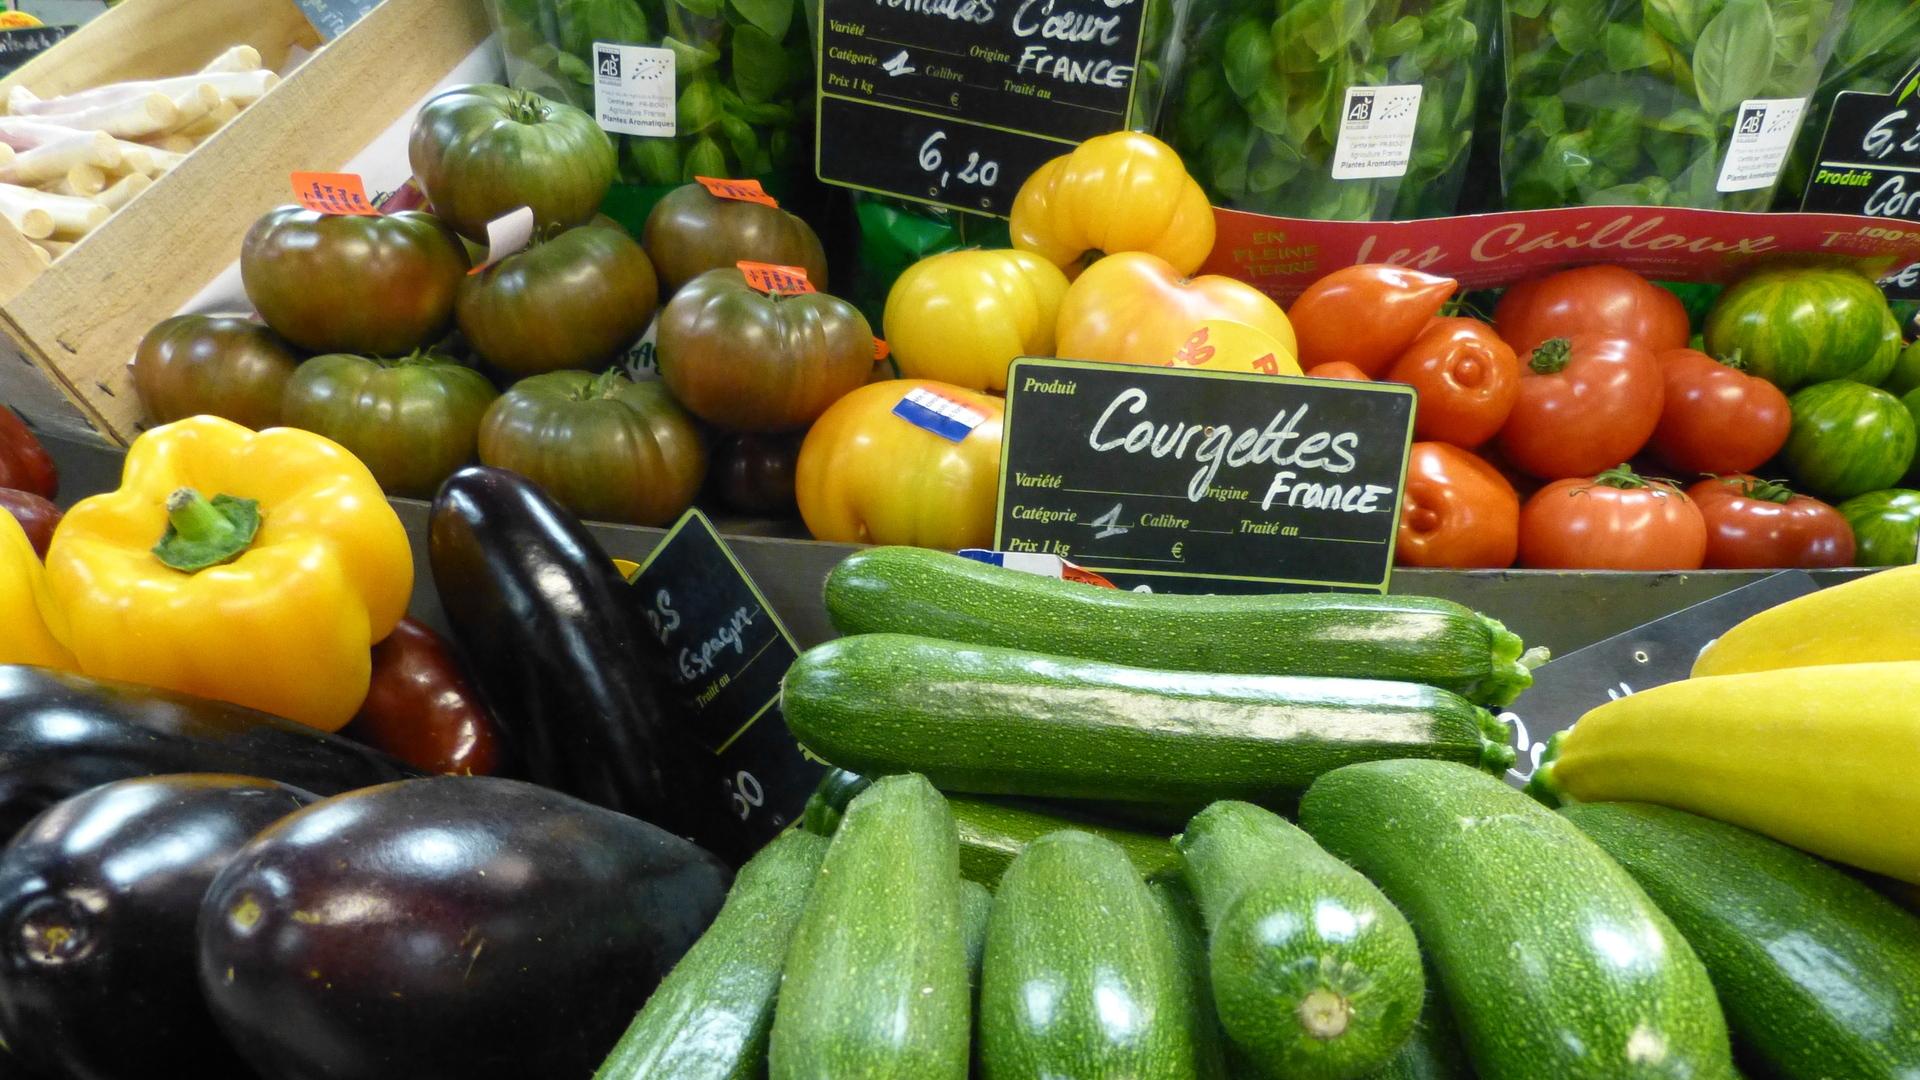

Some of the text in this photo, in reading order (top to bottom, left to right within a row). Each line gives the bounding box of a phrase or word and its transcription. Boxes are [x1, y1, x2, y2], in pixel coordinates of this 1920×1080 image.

[829, 19, 865, 37] Variété
[969, 45, 1011, 63] Origine
[829, 46, 1051, 100] Catégorie 1 Calibre Traité au
[828, 72, 960, 107] Prix 1 kg €
[602, 113, 674, 128] Plantes Aromatiques
[918, 131, 999, 188] 6,20
[1340, 159, 1408, 169] Plantes Aromatiques
[1815, 169, 1872, 187] Produit
[1252, 231, 1286, 246] EN
[1471, 215, 1779, 262] Cailloux
[1232, 245, 1318, 263] PLEINE
[1243, 261, 1317, 279] TERRE
[1023, 377, 1077, 396] Produit
[1089, 387, 1358, 503] Courgettes
[1015, 473, 1062, 490] Variété
[1011, 503, 1299, 540] Catégorie 1 Calibre Traité au
[1008, 538, 1184, 559] Prix 1 kg €
[719, 673, 730, 688] au
